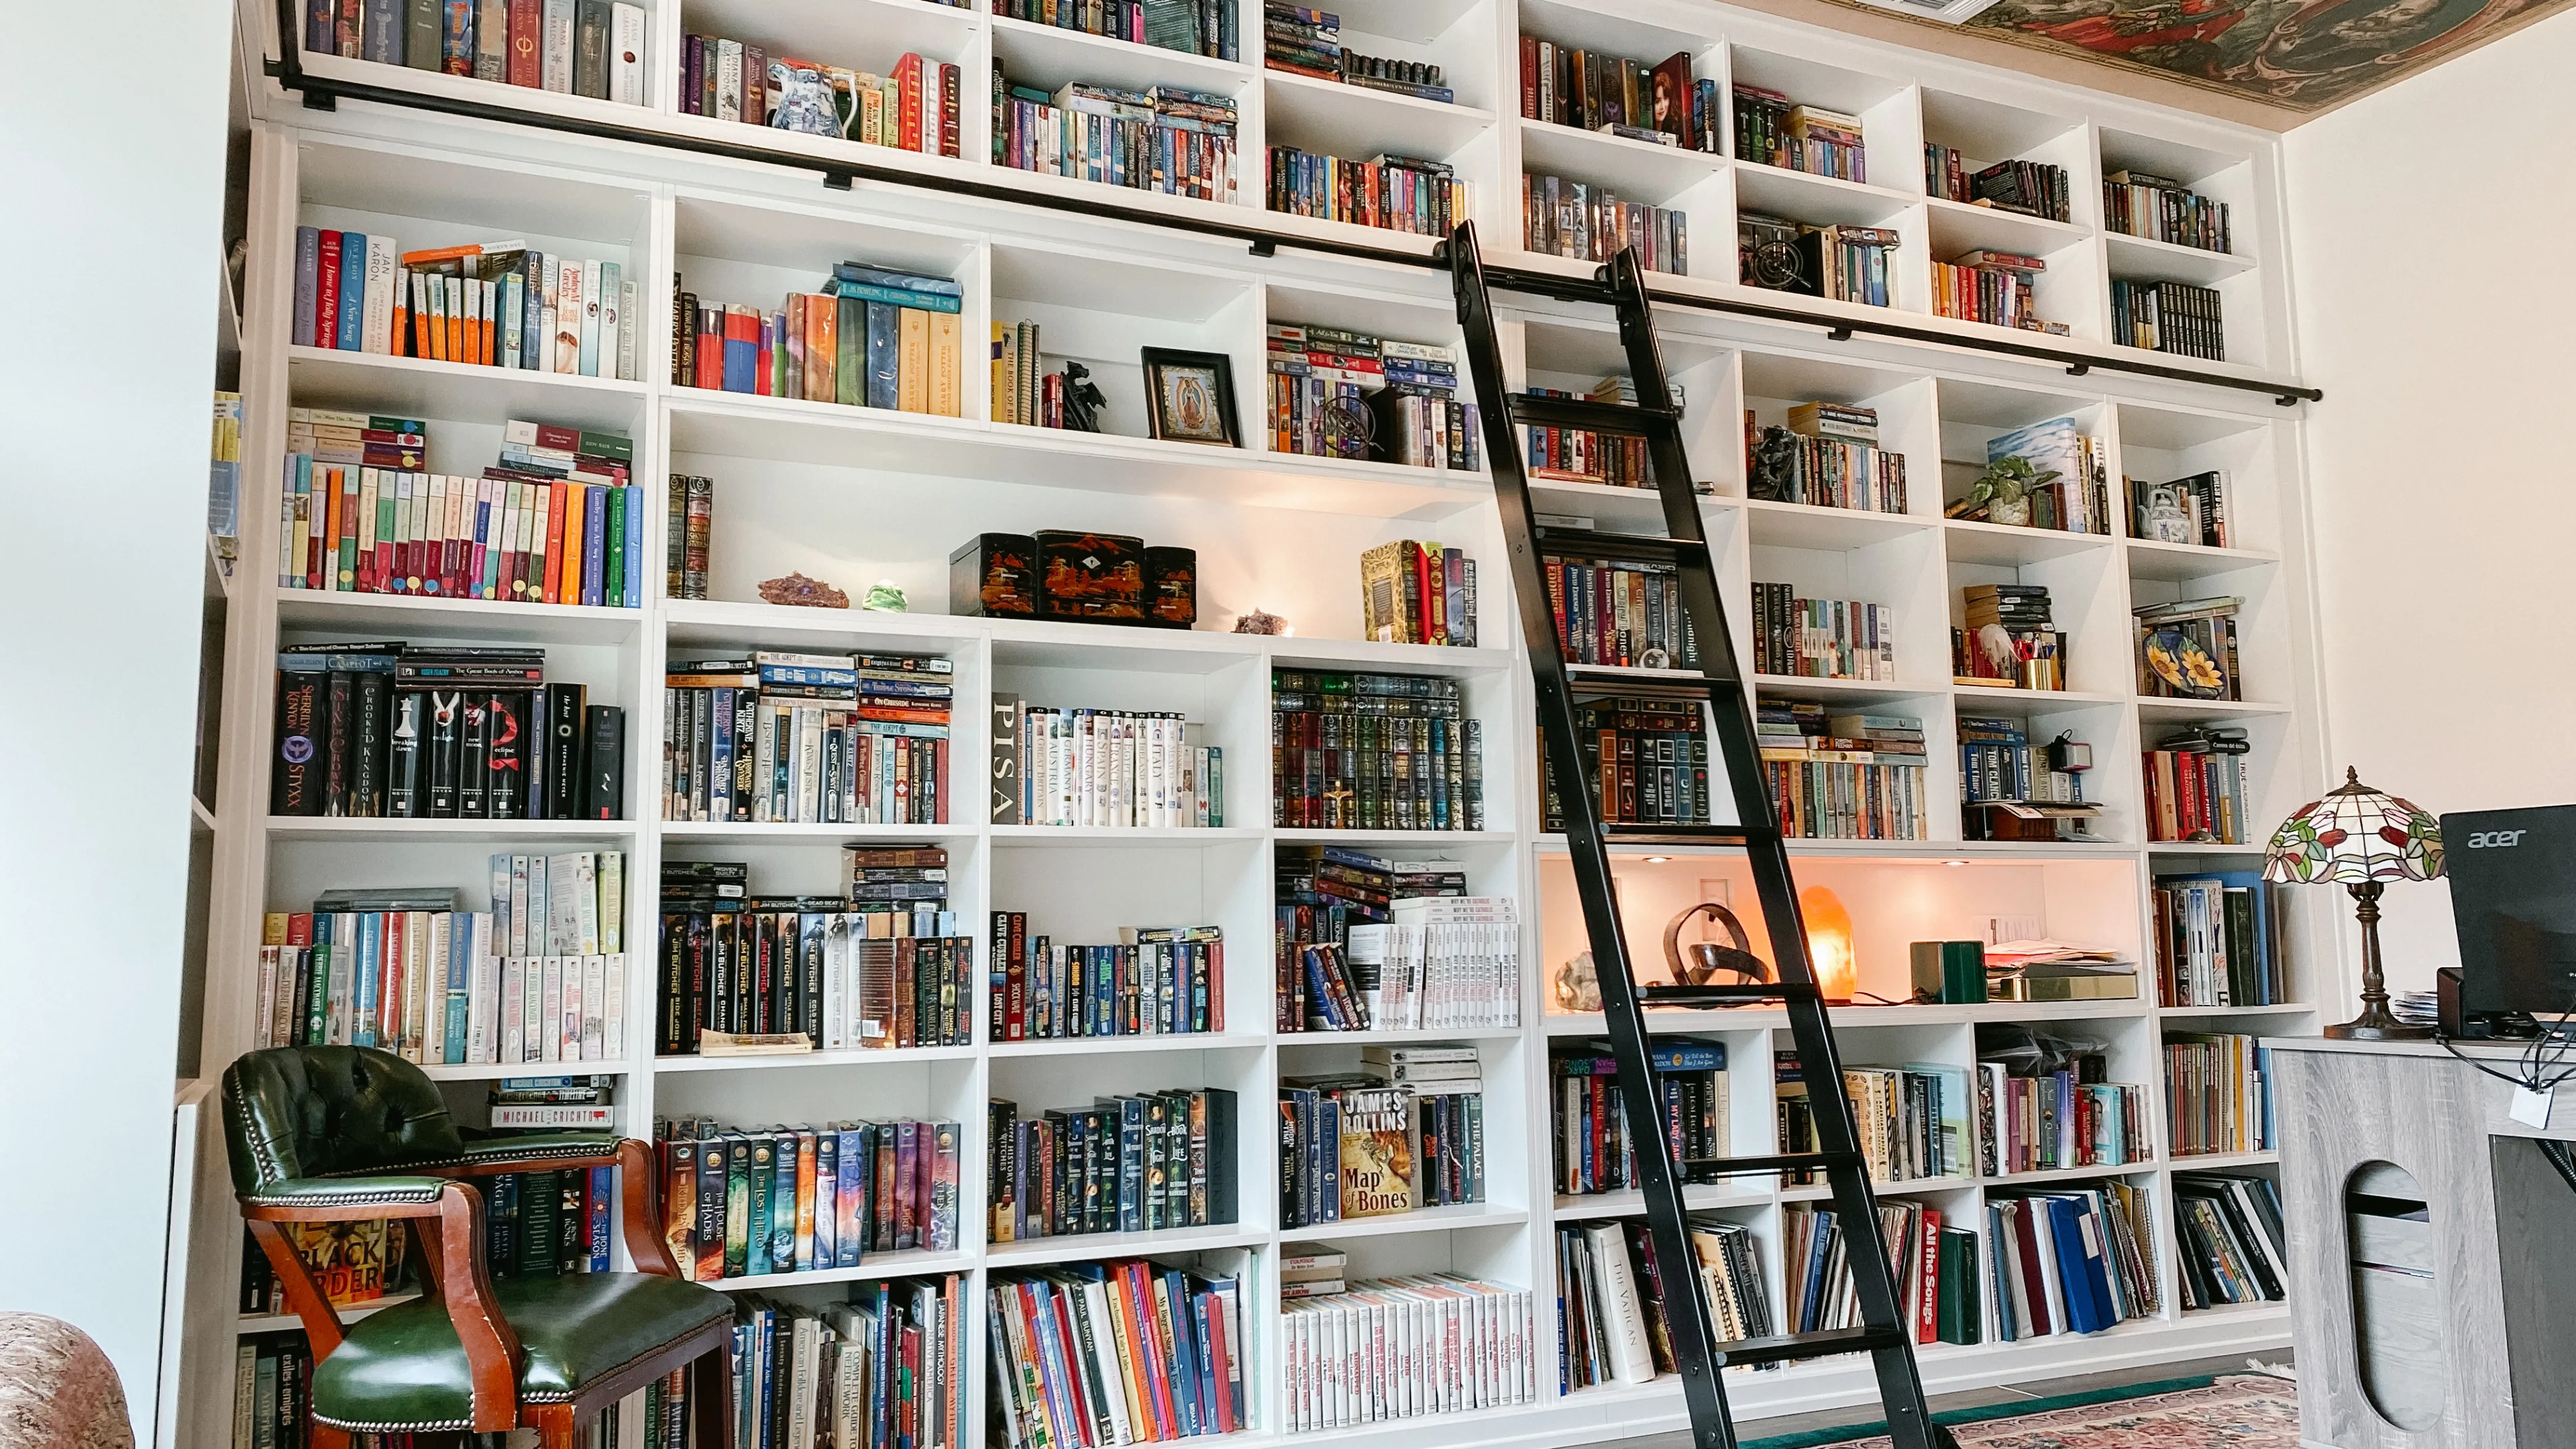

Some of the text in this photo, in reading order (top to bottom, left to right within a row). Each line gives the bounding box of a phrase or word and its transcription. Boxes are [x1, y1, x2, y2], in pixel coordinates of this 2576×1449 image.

[549, 8, 557, 51] GABALDON
[370, 243, 380, 282] KARON
[382, 254, 390, 274] JAN
[377, 290, 385, 331] SOMEWHERE
[593, 492, 602, 514] Lumby
[1619, 625, 1629, 656] Bones
[287, 691, 300, 729] KENYON
[301, 684, 314, 735] SHERRILYN
[722, 693, 731, 738] KATHERINE
[736, 710, 745, 733] KURTZ
[745, 702, 754, 742] KATHERINE
[361, 687, 374, 802] CROOKED KINGDOM
[391, 739, 417, 747] breaking
[494, 747, 515, 757] eclipse
[994, 701, 1014, 820] PISA
[1097, 742, 1107, 780] SPAIN
[1124, 743, 1132, 777] EGYPT
[1152, 743, 1163, 780] ITALY
[1987, 751, 1998, 769] TOM
[1037, 739, 1045, 808] GREAT BRITAIN
[1049, 742, 1057, 794] AUSTRIA
[1084, 739, 1093, 794] HUNGARY
[1110, 742, 1121, 785] FRANCE
[288, 765, 305, 808] STYXX
[2468, 830, 2526, 848] acer
[997, 914, 1006, 972] CLIVE CUSSLER
[1013, 915, 1022, 961] CLIVE CUSSLER
[760, 954, 768, 993] BUTCHER
[927, 1005, 936, 1038] WARLOCK
[994, 993, 1003, 1025] LOST CITY
[503, 1111, 596, 1122] MICHAEL CRICHTO
[1344, 1092, 1403, 1114] JAMES
[1671, 1105, 1678, 1116] MY
[1167, 1124, 1187, 1136] BOOK
[1342, 1112, 1407, 1134] ROLLINS
[998, 1131, 1008, 1171] WITCHES
[1006, 1146, 1014, 1182] HISTORY
[1150, 1150, 1165, 1165] NIGHT
[1170, 1146, 1187, 1161] LIFE
[1473, 1138, 1481, 1179] PALACE
[935, 1178, 945, 1218] ATHENA
[1344, 1168, 1381, 1191] Map
[754, 1174, 766, 1248] THE LOST HERO
[946, 1185, 955, 1213] MARK
[1346, 1191, 1407, 1212] of Bones
[702, 1203, 714, 1241] HADES
[714, 1205, 724, 1241] HOUSE
[1923, 1221, 1937, 1326] All the Songs
[1112, 1297, 1122, 1334] Enchanting
[1614, 1260, 1637, 1346] THE VATICAN
[936, 1303, 946, 1386] JAPANESE MYTHOLOGY
[994, 1324, 1004, 1359] Pocahontas
[1082, 1320, 1094, 1352] BUNYAN
[1159, 1296, 1178, 1390] My Biggest Storybook Ever
[1559, 1343, 1564, 1352] to
[792, 1327, 809, 1449] American Folklore and Legen
[842, 1351, 852, 1419] NEEDLEWORK
[849, 1351, 860, 1449] COMPLETE GUIDE TO
[926, 1364, 934, 1403] AMERICA
[949, 1359, 957, 1436] GREEK MYTHS
[1189, 1402, 1198, 1430] BRIMAX
